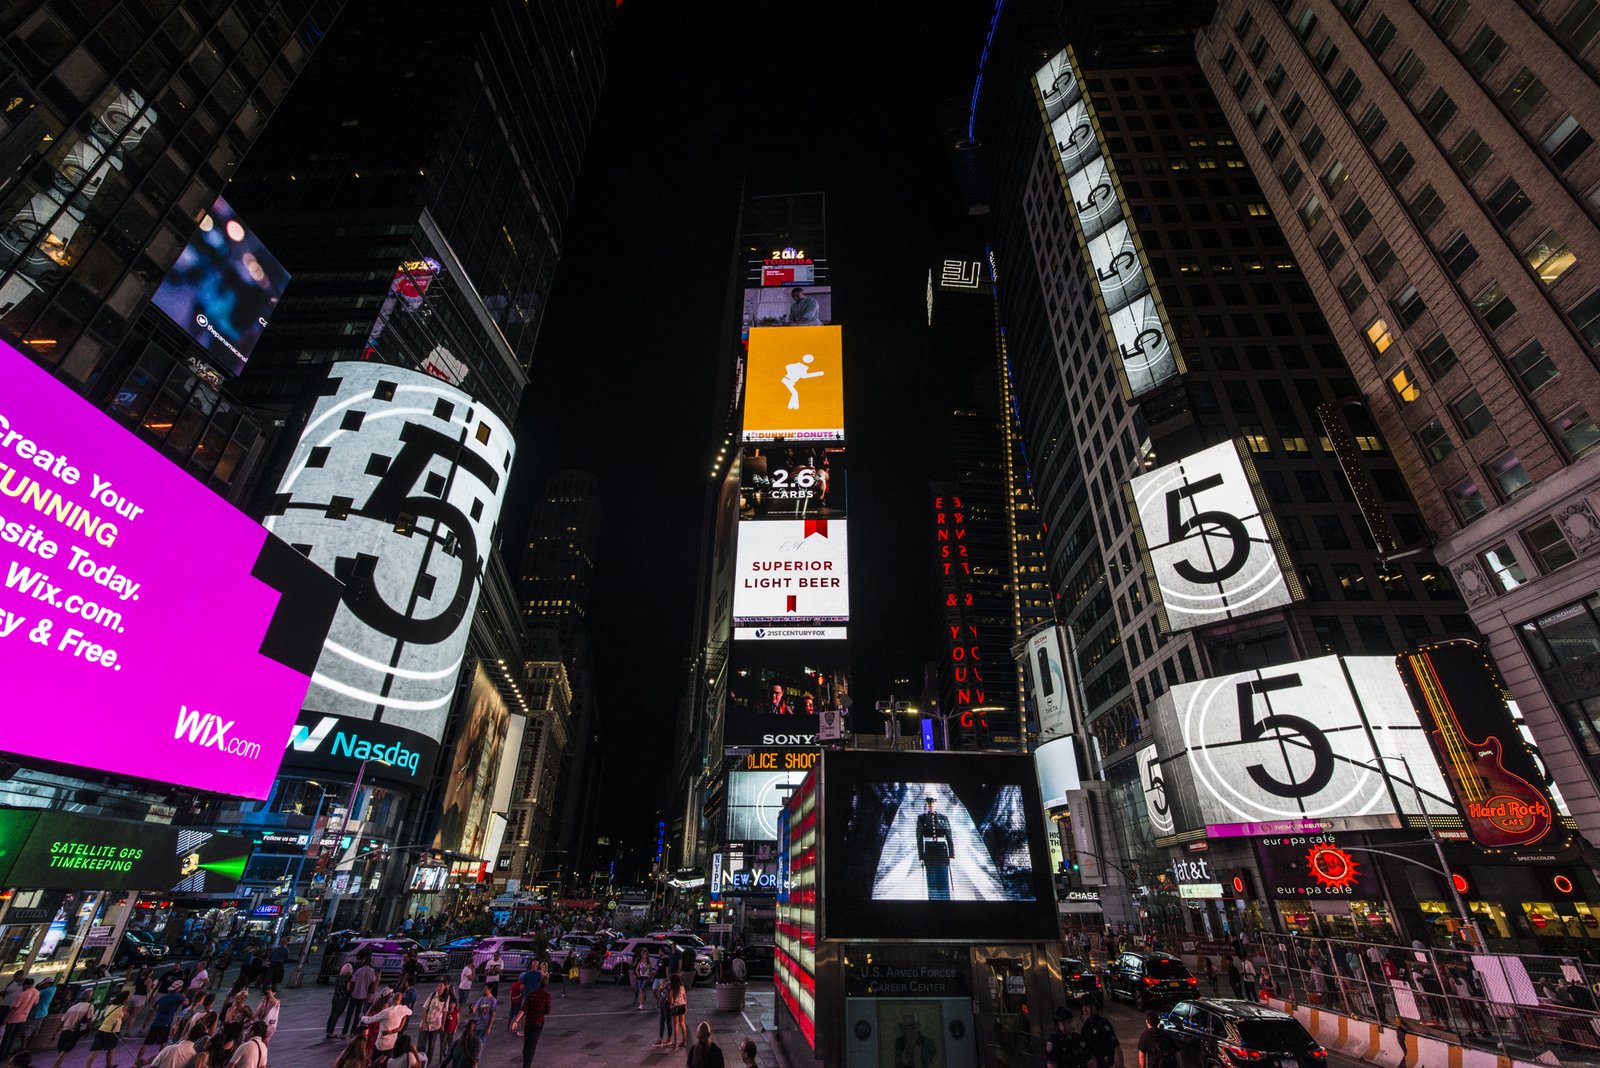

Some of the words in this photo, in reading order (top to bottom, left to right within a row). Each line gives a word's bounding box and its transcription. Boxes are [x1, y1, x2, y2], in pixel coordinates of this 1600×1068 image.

[772, 468, 815, 488] 2.6
[90, 473, 144, 521] Your
[936, 498, 951, 574] ERNST
[1166, 473, 1250, 584] 5
[68, 545, 141, 600] Today.
[752, 561, 833, 571] SUPERIOR
[745, 578, 792, 588] LIGHT
[799, 578, 840, 588] BEER
[5, 561, 124, 633] Wix.com.
[946, 594, 957, 606] &
[28, 618, 53, 646] &
[58, 628, 121, 671] Free.
[951, 626, 972, 727] YOUNG
[763, 734, 814, 744] SONY
[1236, 672, 1335, 798] 5
[330, 732, 420, 776] Nasdaq
[748, 753, 778, 769] OLICE
[1469, 803, 1506, 817] Hard
[1508, 801, 1548, 818] Rock
[1309, 834, 1336, 843] café
[50, 842, 115, 858] SATELLITE
[119, 848, 143, 860] GPS
[50, 856, 133, 871] TIMEKEEPING
[1178, 858, 1210, 880] at&t
[752, 869, 776, 886] YOR
[1325, 884, 1352, 894] café
[861, 967, 884, 978] U.S.
[886, 967, 918, 978] ARMED
[920, 967, 956, 978] FORCES
[870, 980, 908, 992] CAREER
[909, 980, 945, 992] CENTER
